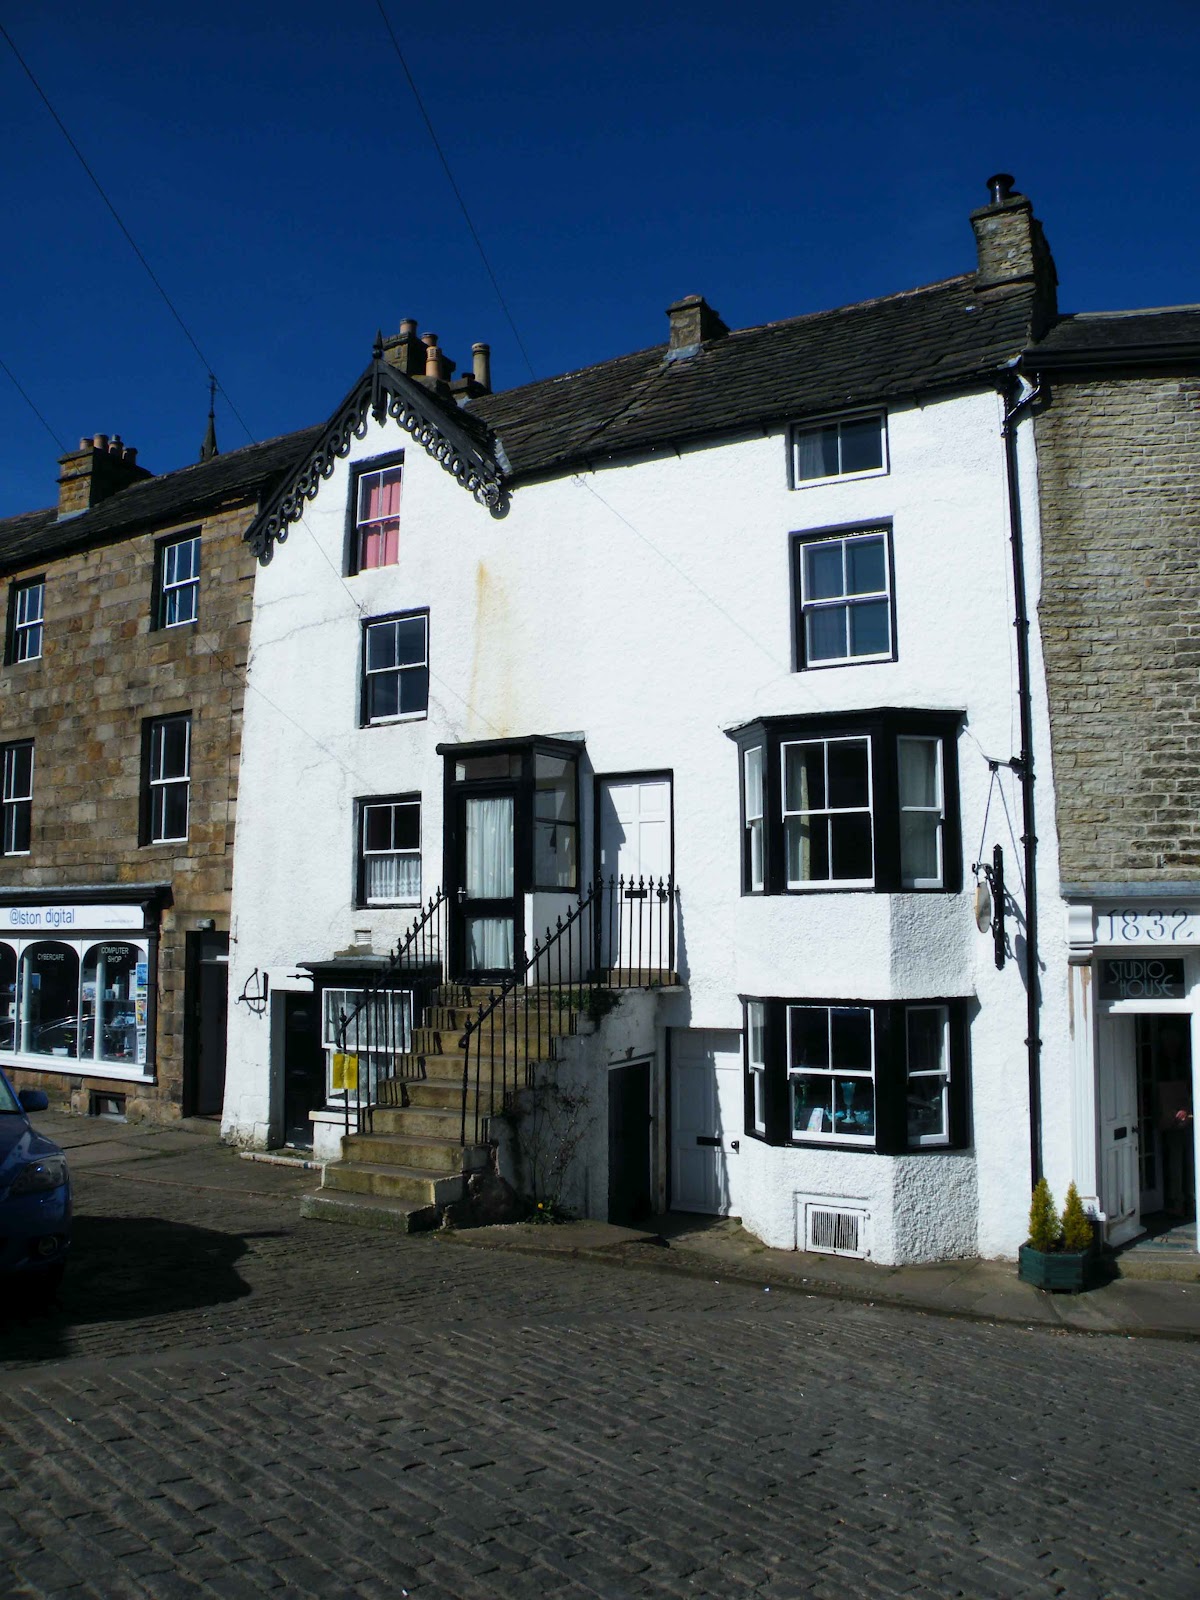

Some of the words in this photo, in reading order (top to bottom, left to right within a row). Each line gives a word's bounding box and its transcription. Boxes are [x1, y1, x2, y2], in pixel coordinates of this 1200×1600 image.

[10, 908, 41, 925] @lston
[46, 908, 75, 927] digital
[1106, 908, 1193, 940] 1832
[37, 953, 65, 961] CYBERCAFE
[101, 946, 129, 955] COMPUTER
[107, 955, 122, 963] SHOP
[1109, 960, 1165, 984] STUDIO
[1119, 974, 1175, 996] HOUSE
